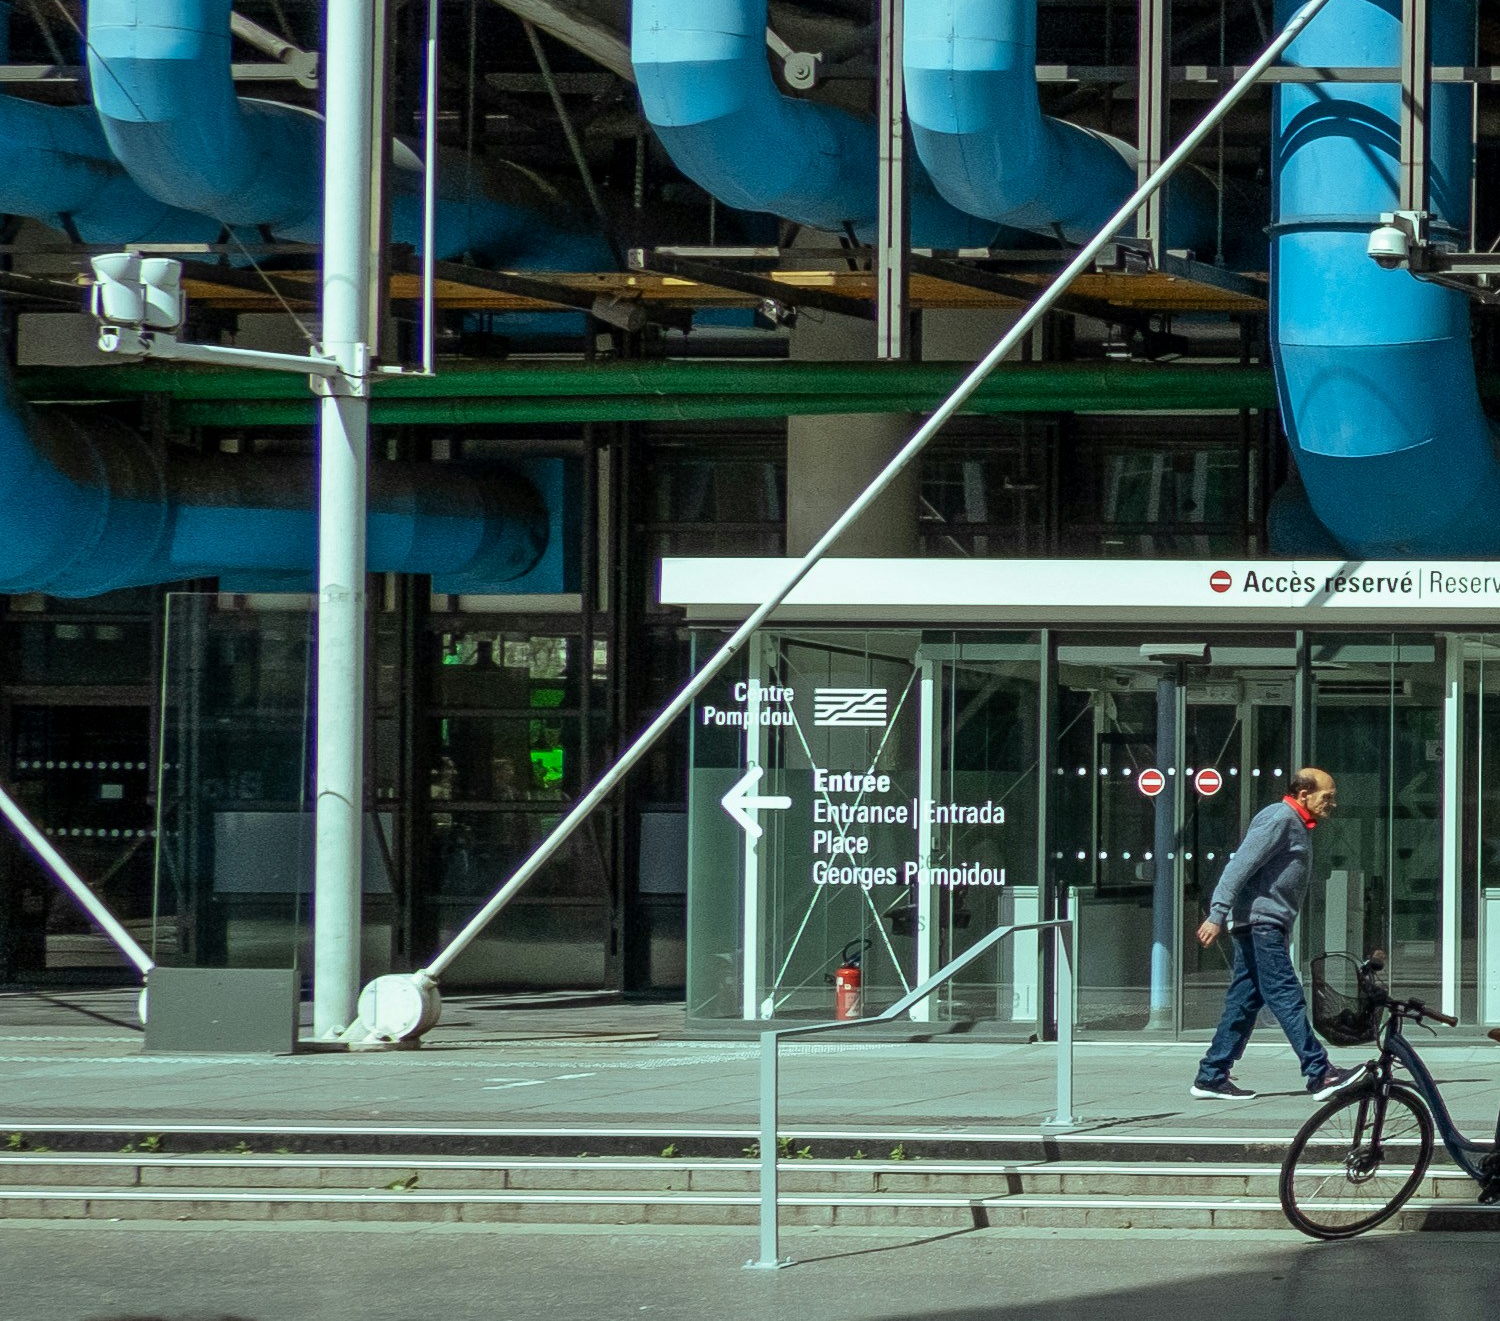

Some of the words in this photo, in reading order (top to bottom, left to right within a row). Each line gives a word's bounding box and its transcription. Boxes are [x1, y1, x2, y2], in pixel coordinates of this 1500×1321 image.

[1243, 570, 1316, 594] Accès
[1325, 570, 1413, 594] réservé
[734, 682, 795, 702] Centre
[703, 705, 794, 731] Pompidou
[814, 767, 891, 793] Entrée
[813, 799, 909, 824] Entrance
[923, 800, 1006, 825] Entrada
[813, 829, 869, 854] Place
[812, 860, 898, 891] Georges
[904, 861, 1006, 892] Pompidou
